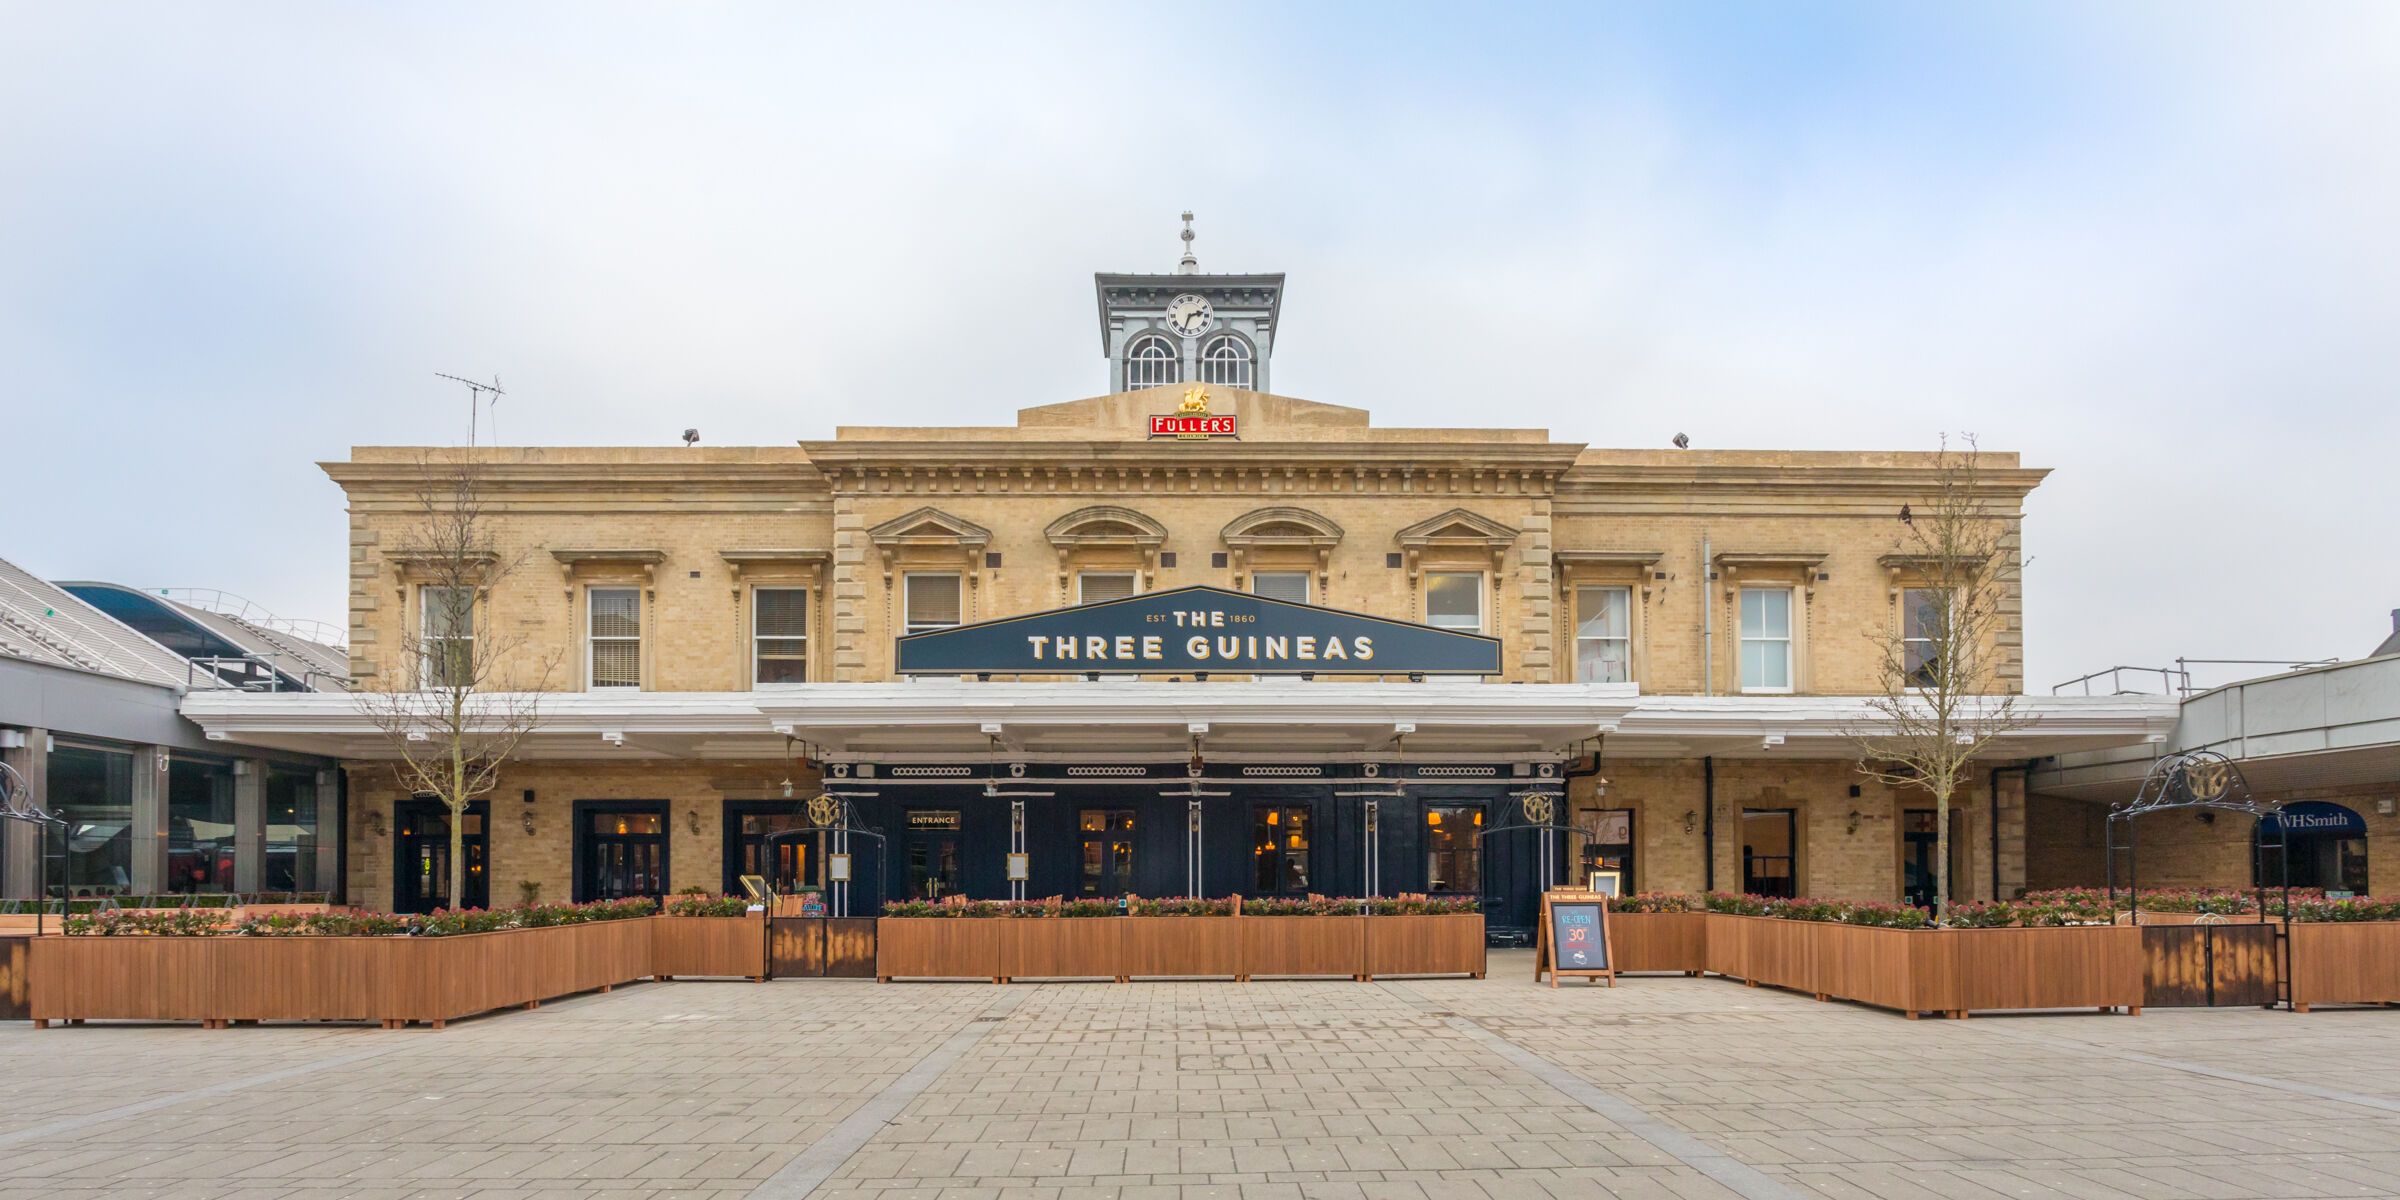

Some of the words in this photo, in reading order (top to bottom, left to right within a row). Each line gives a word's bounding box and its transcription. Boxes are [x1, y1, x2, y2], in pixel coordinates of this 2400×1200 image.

[1155, 418, 1231, 433] FULLER'S
[1146, 614, 1167, 622] EST.
[1173, 611, 1225, 627] THE
[1230, 615, 1256, 623] 1860
[1028, 636, 1163, 660] THREE
[1186, 635, 1374, 660] GUINEAS
[2277, 812, 2349, 828] WHSmith
